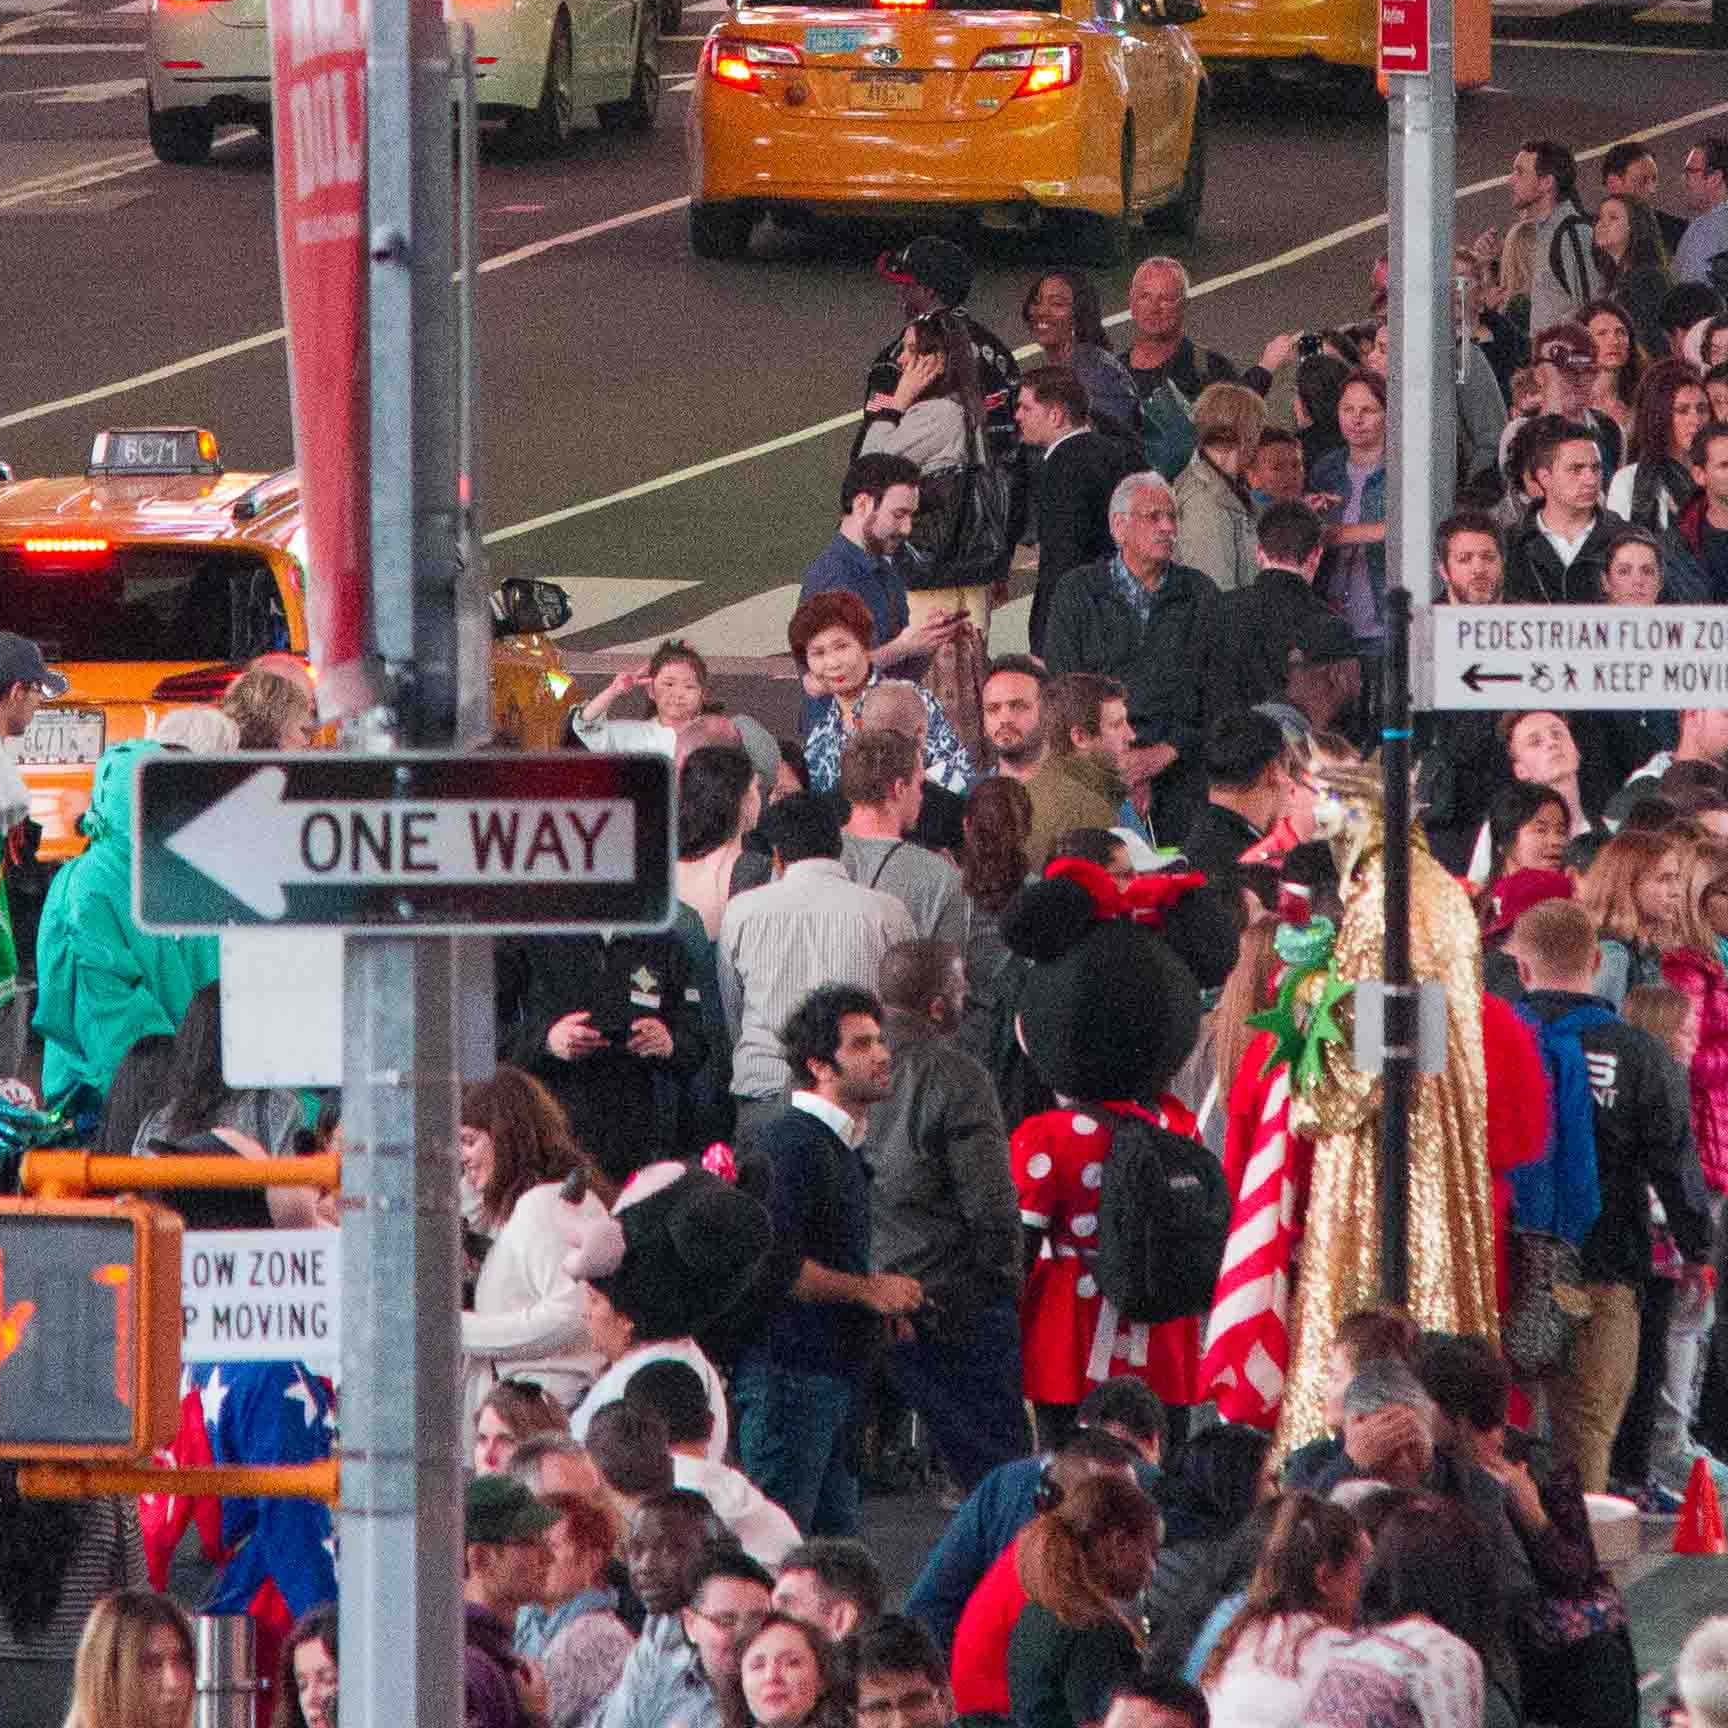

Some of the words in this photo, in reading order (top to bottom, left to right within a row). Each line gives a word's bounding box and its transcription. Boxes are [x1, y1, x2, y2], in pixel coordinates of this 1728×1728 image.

[1457, 619, 1610, 652] PEDESTRIAN
[1618, 619, 1686, 651] FLOW
[1592, 662, 1654, 693] KEEP
[299, 809, 439, 873] ONE
[472, 807, 614, 871] WAY
[183, 1251, 235, 1286] OW
[248, 1250, 327, 1286] ZONE
[213, 1302, 329, 1339] MOVING
